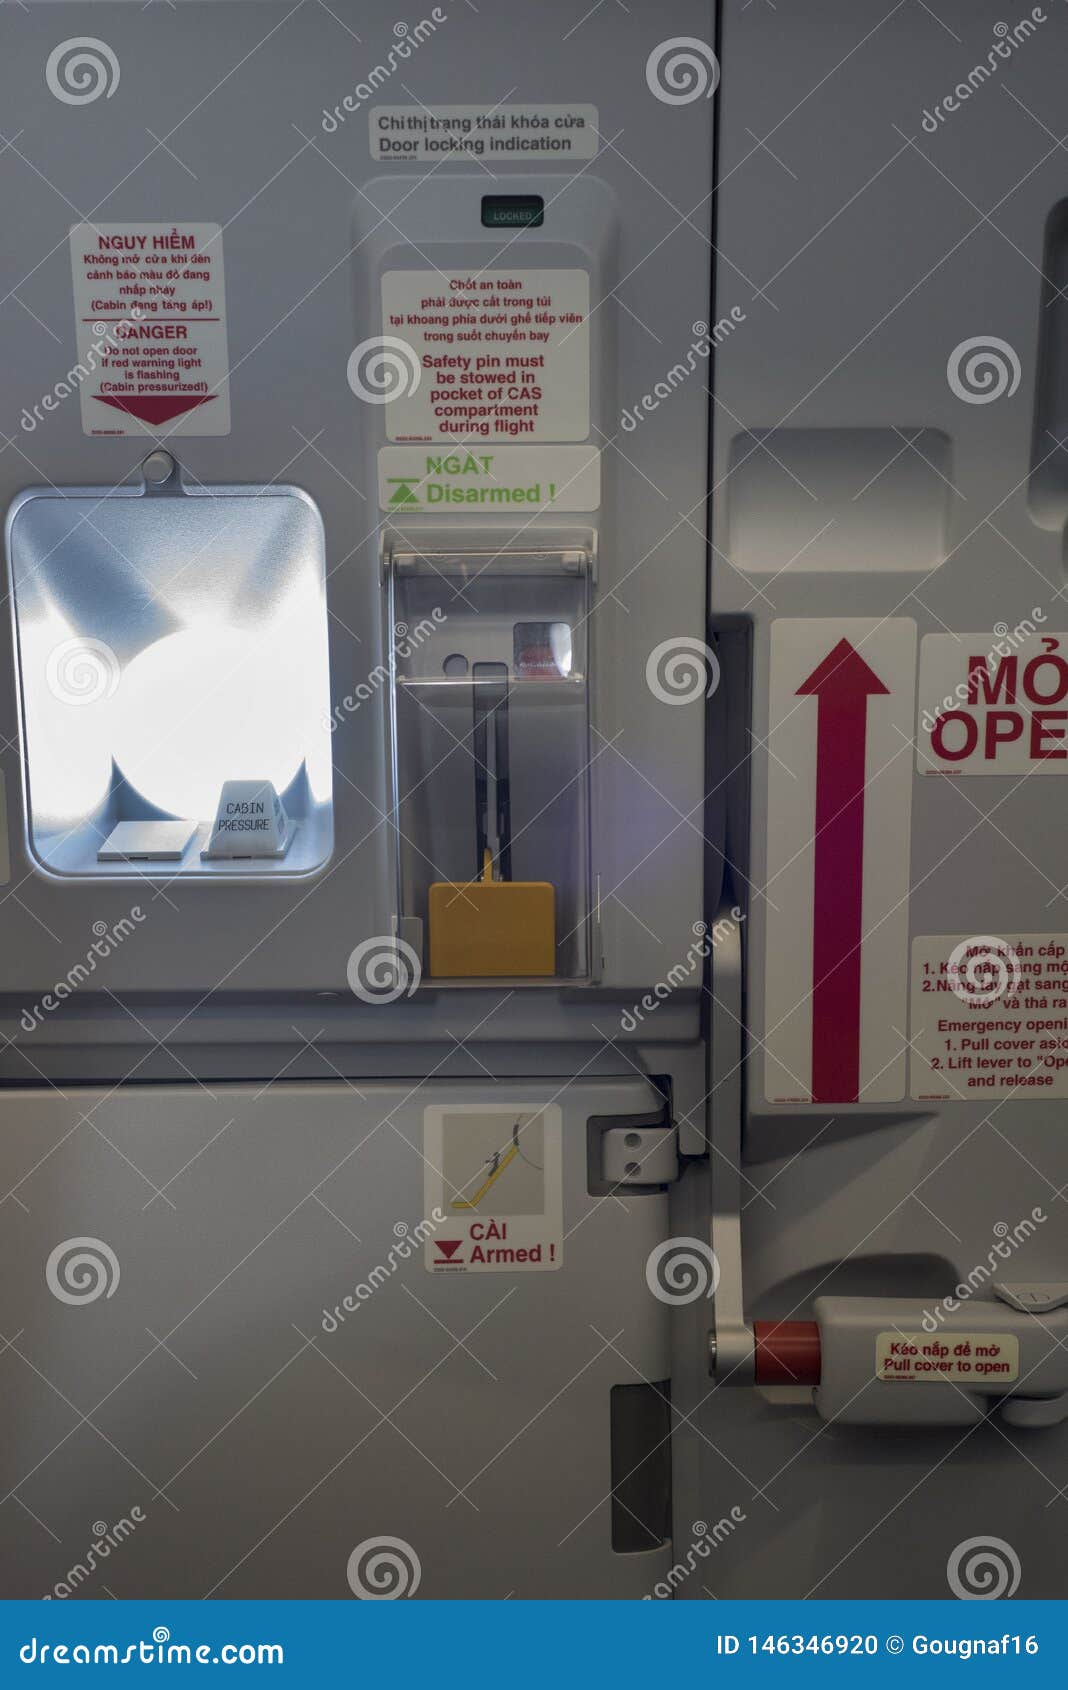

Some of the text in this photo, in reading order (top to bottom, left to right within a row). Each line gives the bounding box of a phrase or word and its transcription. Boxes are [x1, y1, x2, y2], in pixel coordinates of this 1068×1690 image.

[380, 136, 571, 154] Door locking indication
[494, 211, 532, 221] LOCKED
[99, 235, 147, 250] NGUY
[171, 254, 188, 264] khi
[479, 281, 494, 289] an
[91, 300, 126, 312] (Cabin
[503, 297, 534, 309] trong
[407, 314, 449, 327] khoang
[116, 325, 187, 339] DANGER
[424, 331, 453, 344] trong
[529, 331, 550, 343] bay
[104, 345, 198, 358] Do not open door
[102, 358, 202, 369] if red warning light
[422, 354, 545, 371] Safety pin must
[125, 370, 180, 381] is flashing
[436, 370, 535, 384] be stowed in
[100, 382, 208, 394] (Cabin pressurized!)
[430, 386, 542, 403] pocket of CAS
[434, 403, 539, 419] compartment
[439, 420, 535, 435] during flight
[426, 483, 541, 503] Disarmed
[930, 710, 1068, 761] OPE
[226, 802, 264, 814] CABIN
[218, 819, 271, 832] PRESSURE
[924, 962, 936, 974] 1.
[938, 1020, 1022, 1034] Emergency
[945, 1039, 957, 1051] 1.
[961, 1038, 989, 1050] Pull
[994, 1038, 1035, 1049] cover
[930, 1057, 943, 1070] 2.
[948, 1057, 972, 1069] Lift
[977, 1055, 1012, 1068] lever
[1017, 1055, 1032, 1068] to
[967, 1074, 1053, 1087] and release
[469, 1218, 507, 1240] CÀI
[469, 1244, 556, 1263] Armed !
[884, 1358, 1010, 1375] Pull cover to open
